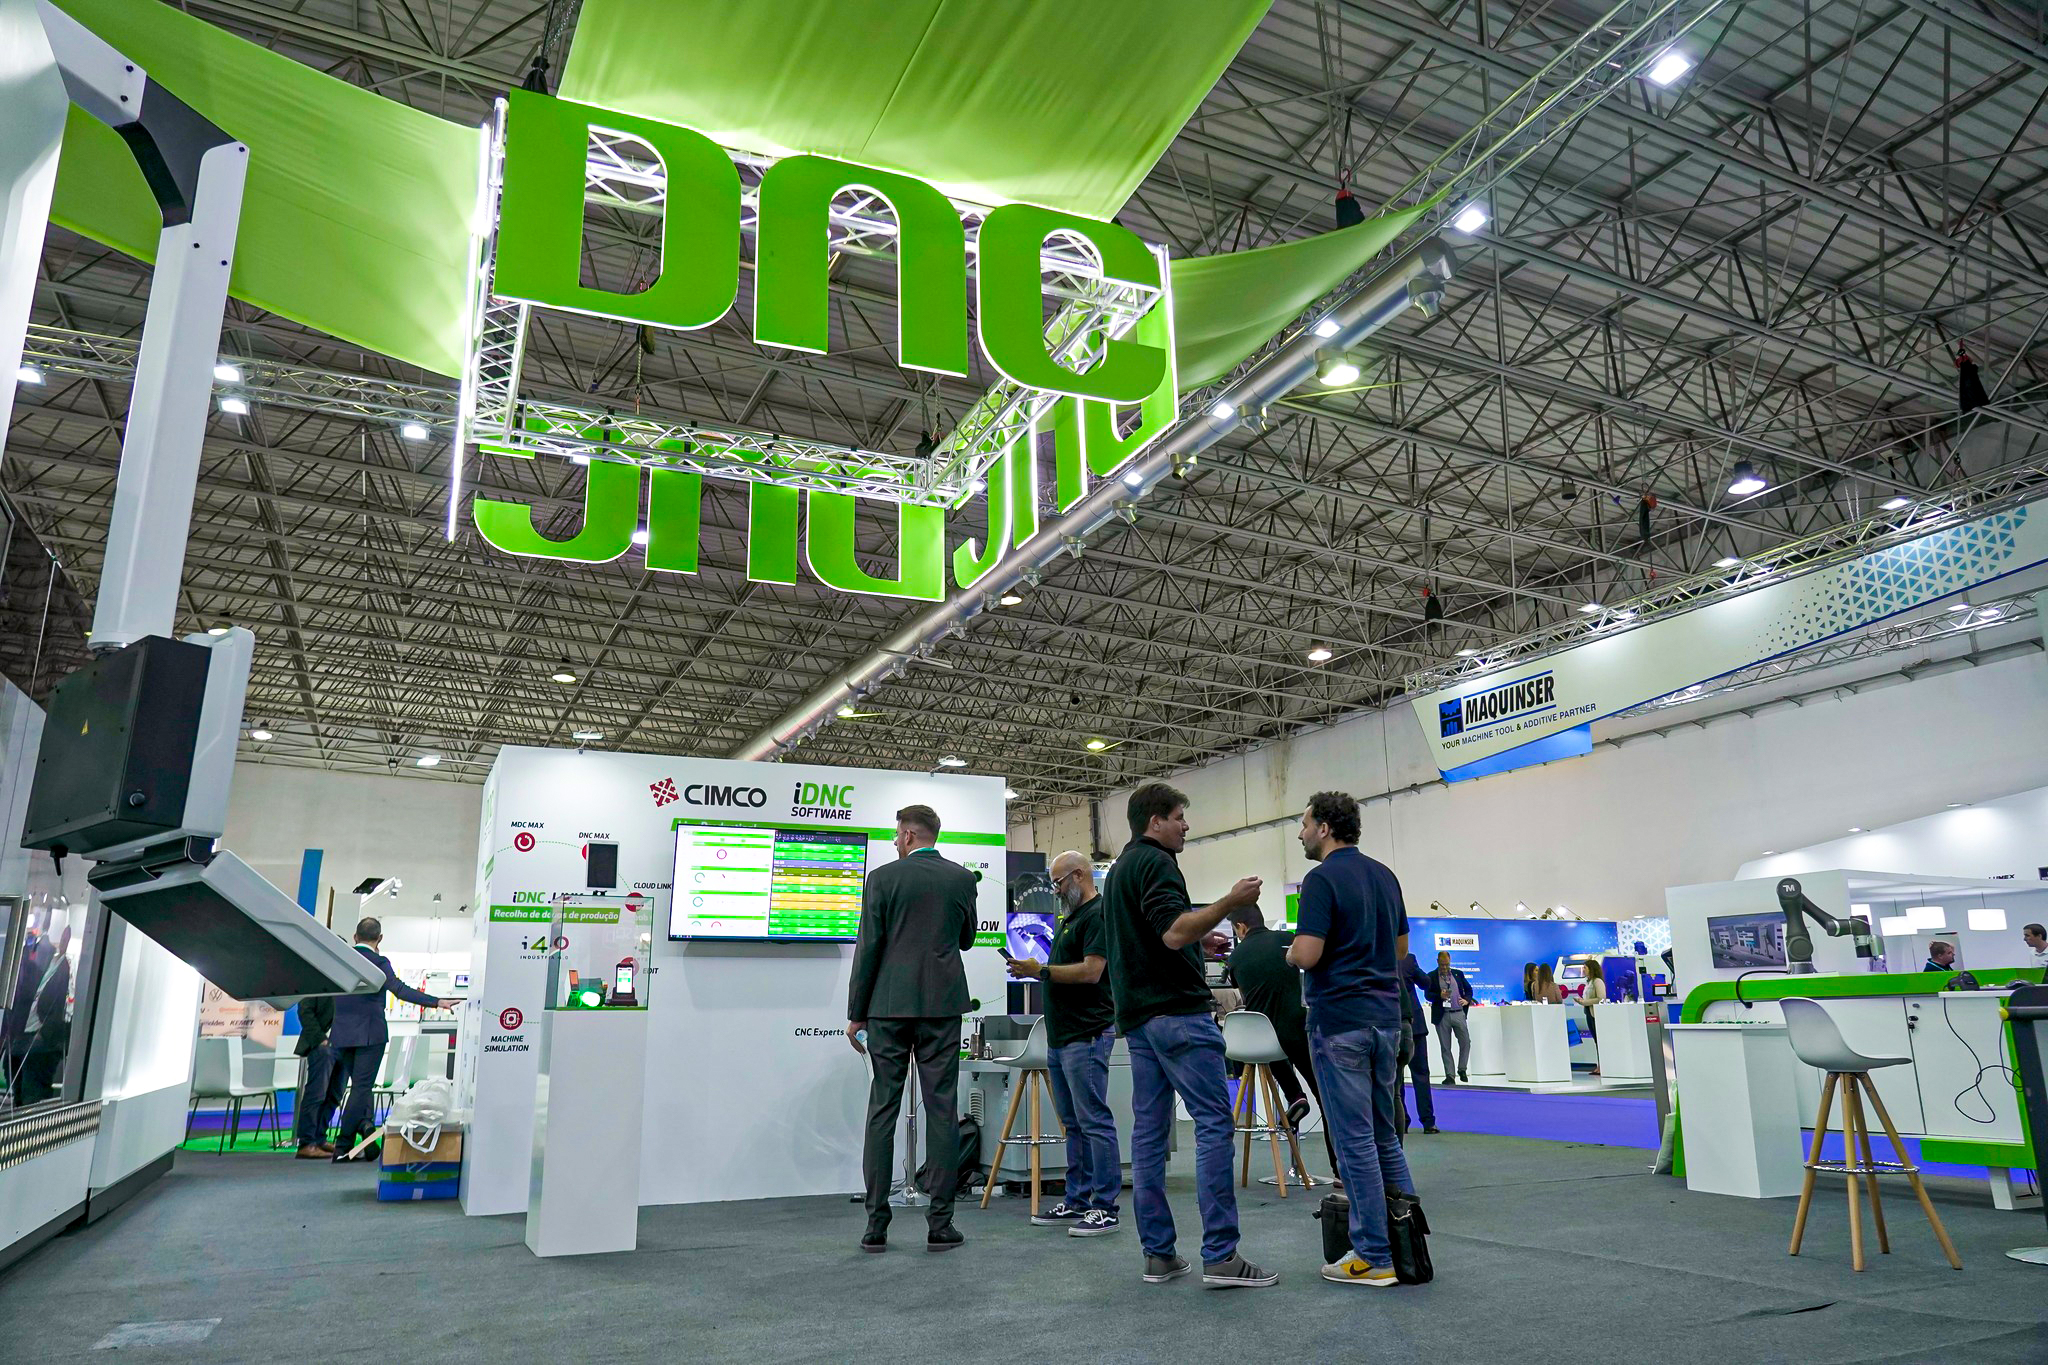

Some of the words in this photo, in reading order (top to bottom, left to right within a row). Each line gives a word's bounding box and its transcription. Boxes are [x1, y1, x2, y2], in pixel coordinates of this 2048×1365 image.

[1465, 675, 1556, 725] MAQUINSER
[1441, 738, 1461, 750] YOUR
[1461, 730, 1494, 745] MACHINE
[1495, 725, 1515, 736] TOOL
[1516, 723, 1522, 731] &
[1523, 713, 1558, 729] ADDITIVE
[1559, 702, 1597, 719] PARTNER
[684, 784, 767, 808] CIMCO
[793, 781, 855, 808] iDNC
[790, 806, 852, 820] SOFTWARE
[510, 821, 527, 829] MDC
[593, 832, 610, 840] MAX
[633, 882, 656, 890] CLOUD
[656, 882, 672, 890] LINK
[512, 891, 546, 904] iDNC
[493, 908, 529, 919] Recolha
[529, 910, 540, 919] de
[568, 911, 579, 919] de
[579, 910, 619, 921] produção
[974, 936, 1001, 946] rodução
[794, 1027, 812, 1037] CNC
[813, 1027, 845, 1038] Experts
[490, 1035, 524, 1043] MACHINE
[484, 1044, 530, 1053] SIMULATION
